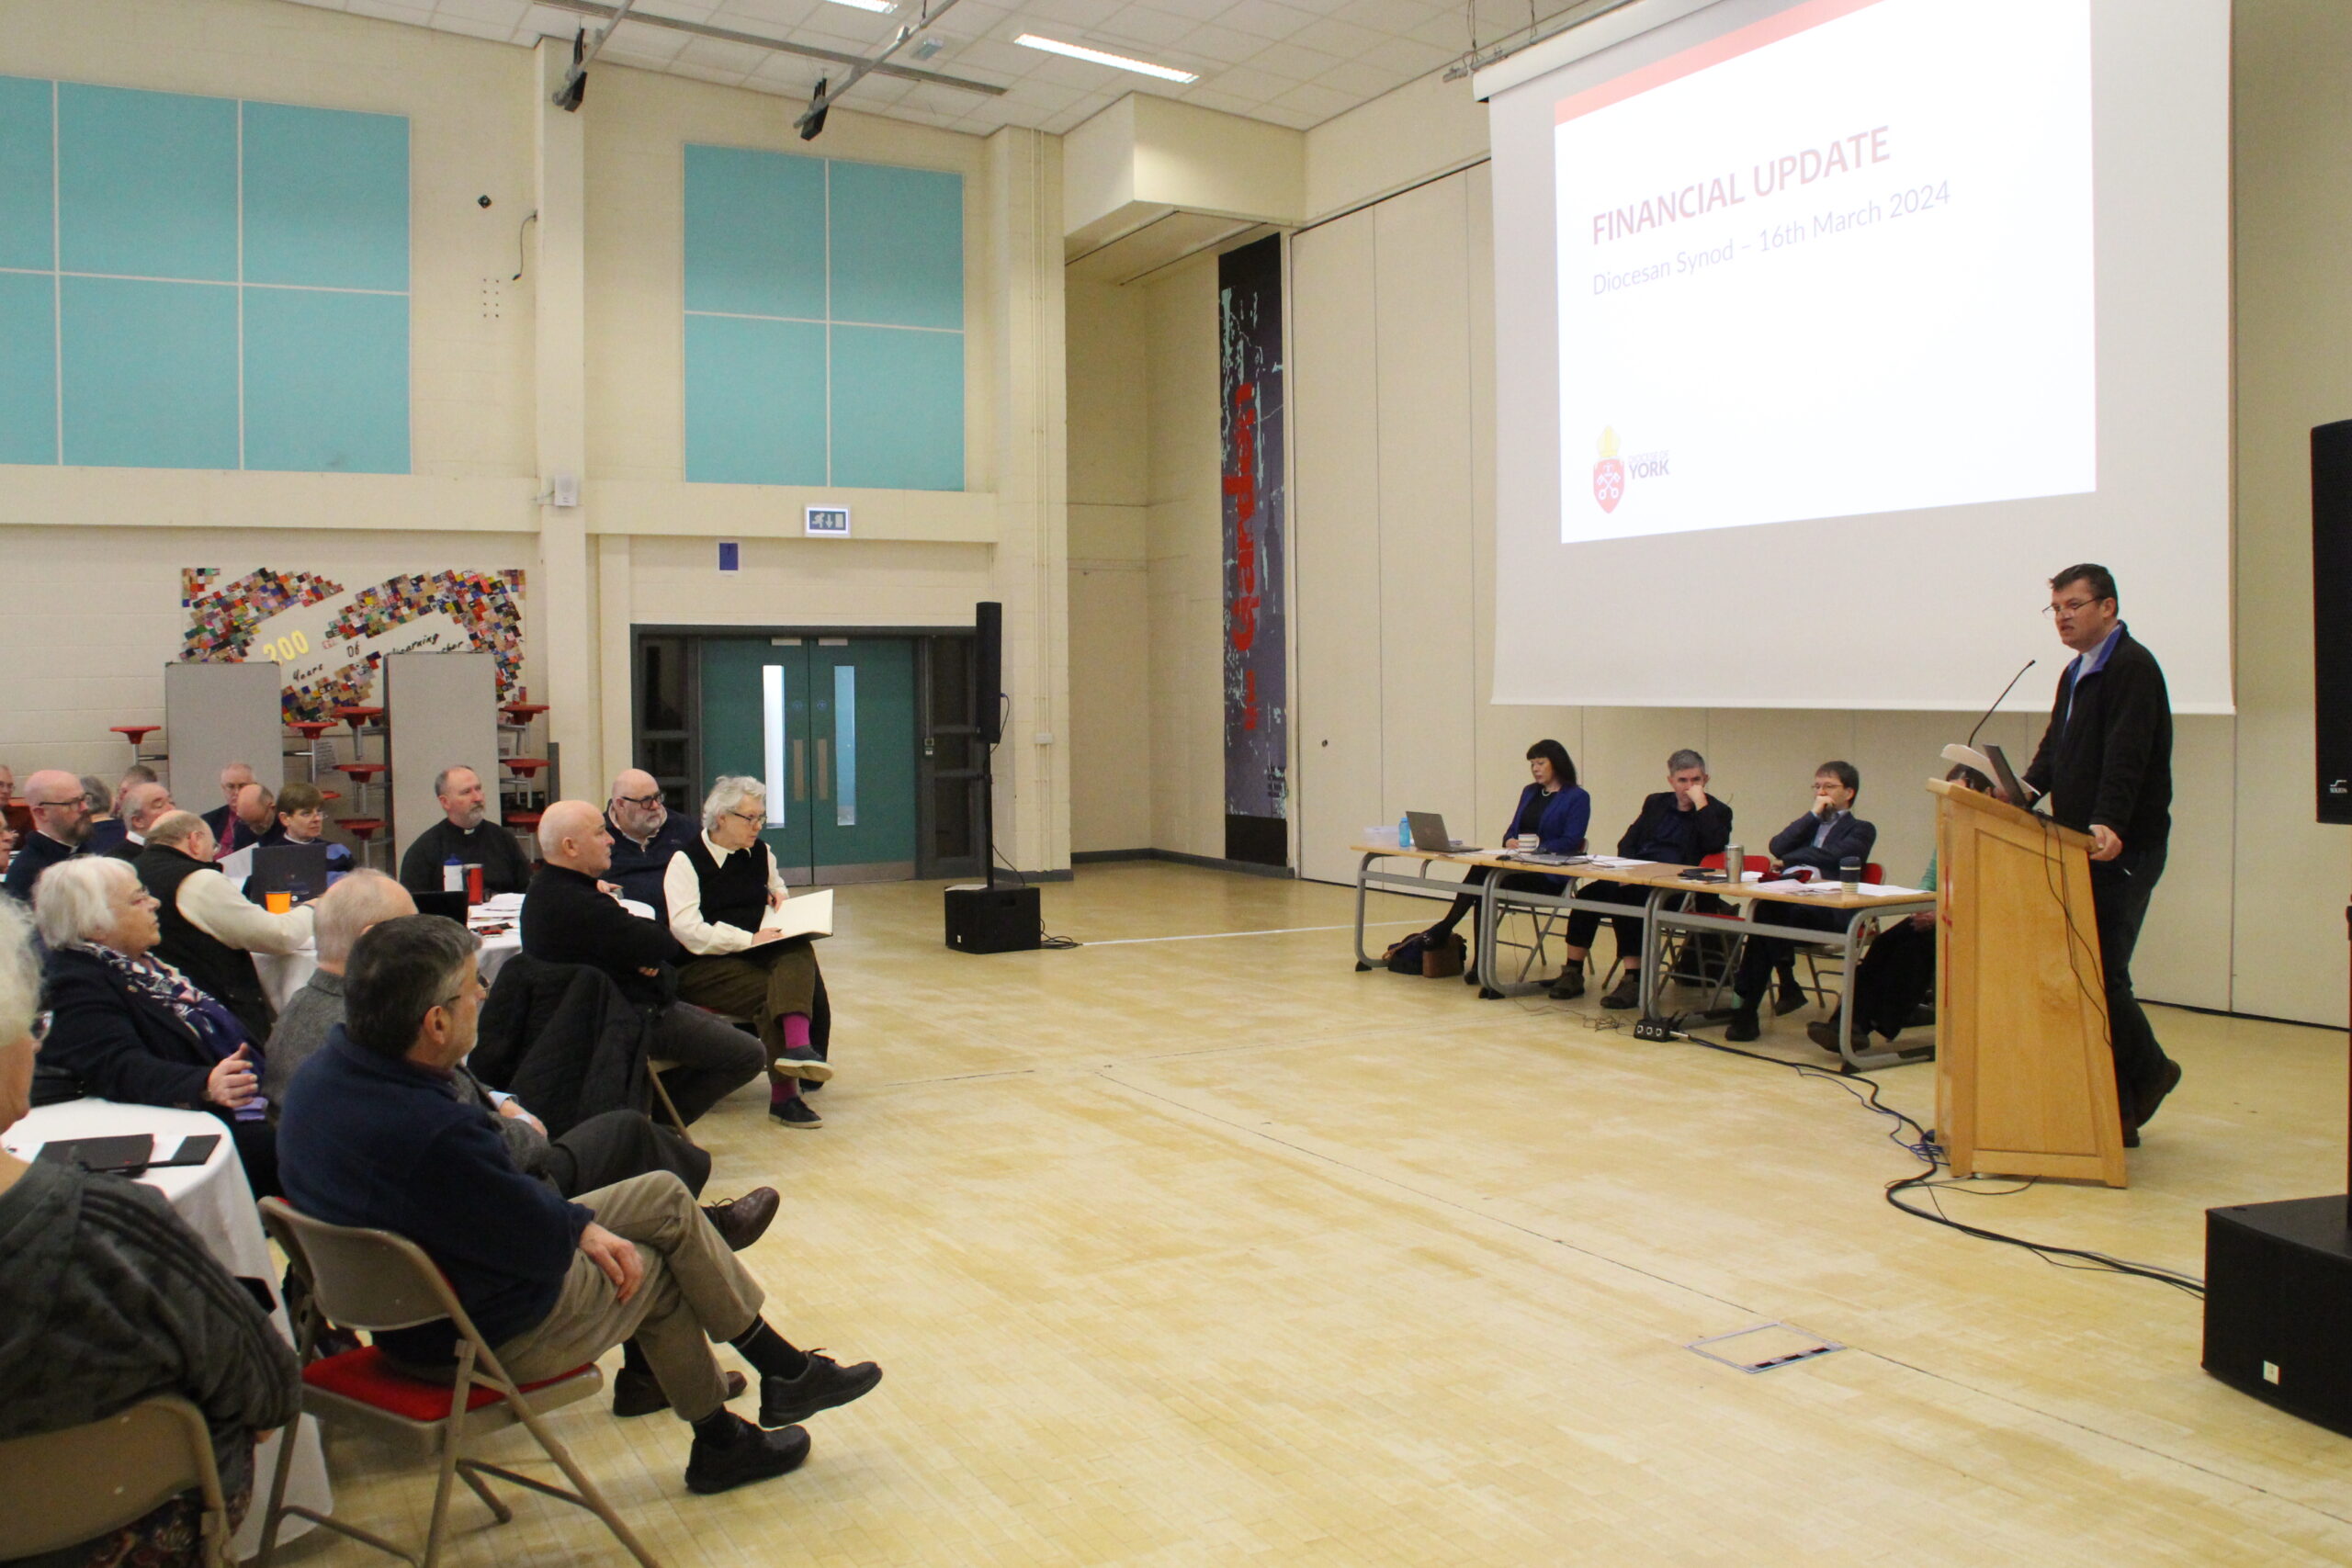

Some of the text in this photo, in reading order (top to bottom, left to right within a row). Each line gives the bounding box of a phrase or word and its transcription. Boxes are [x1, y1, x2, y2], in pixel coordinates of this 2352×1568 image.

[1592, 124, 1891, 246] FINANCIAL UPDATE
[1593, 262, 1671, 296] Diocesan
[1677, 238, 1734, 276] Synod
[1759, 220, 1805, 253] 16th
[1813, 200, 1883, 239] March
[1889, 180, 1951, 220] 2024
[1628, 458, 1669, 480] YORK
[263, 630, 310, 666] 200
